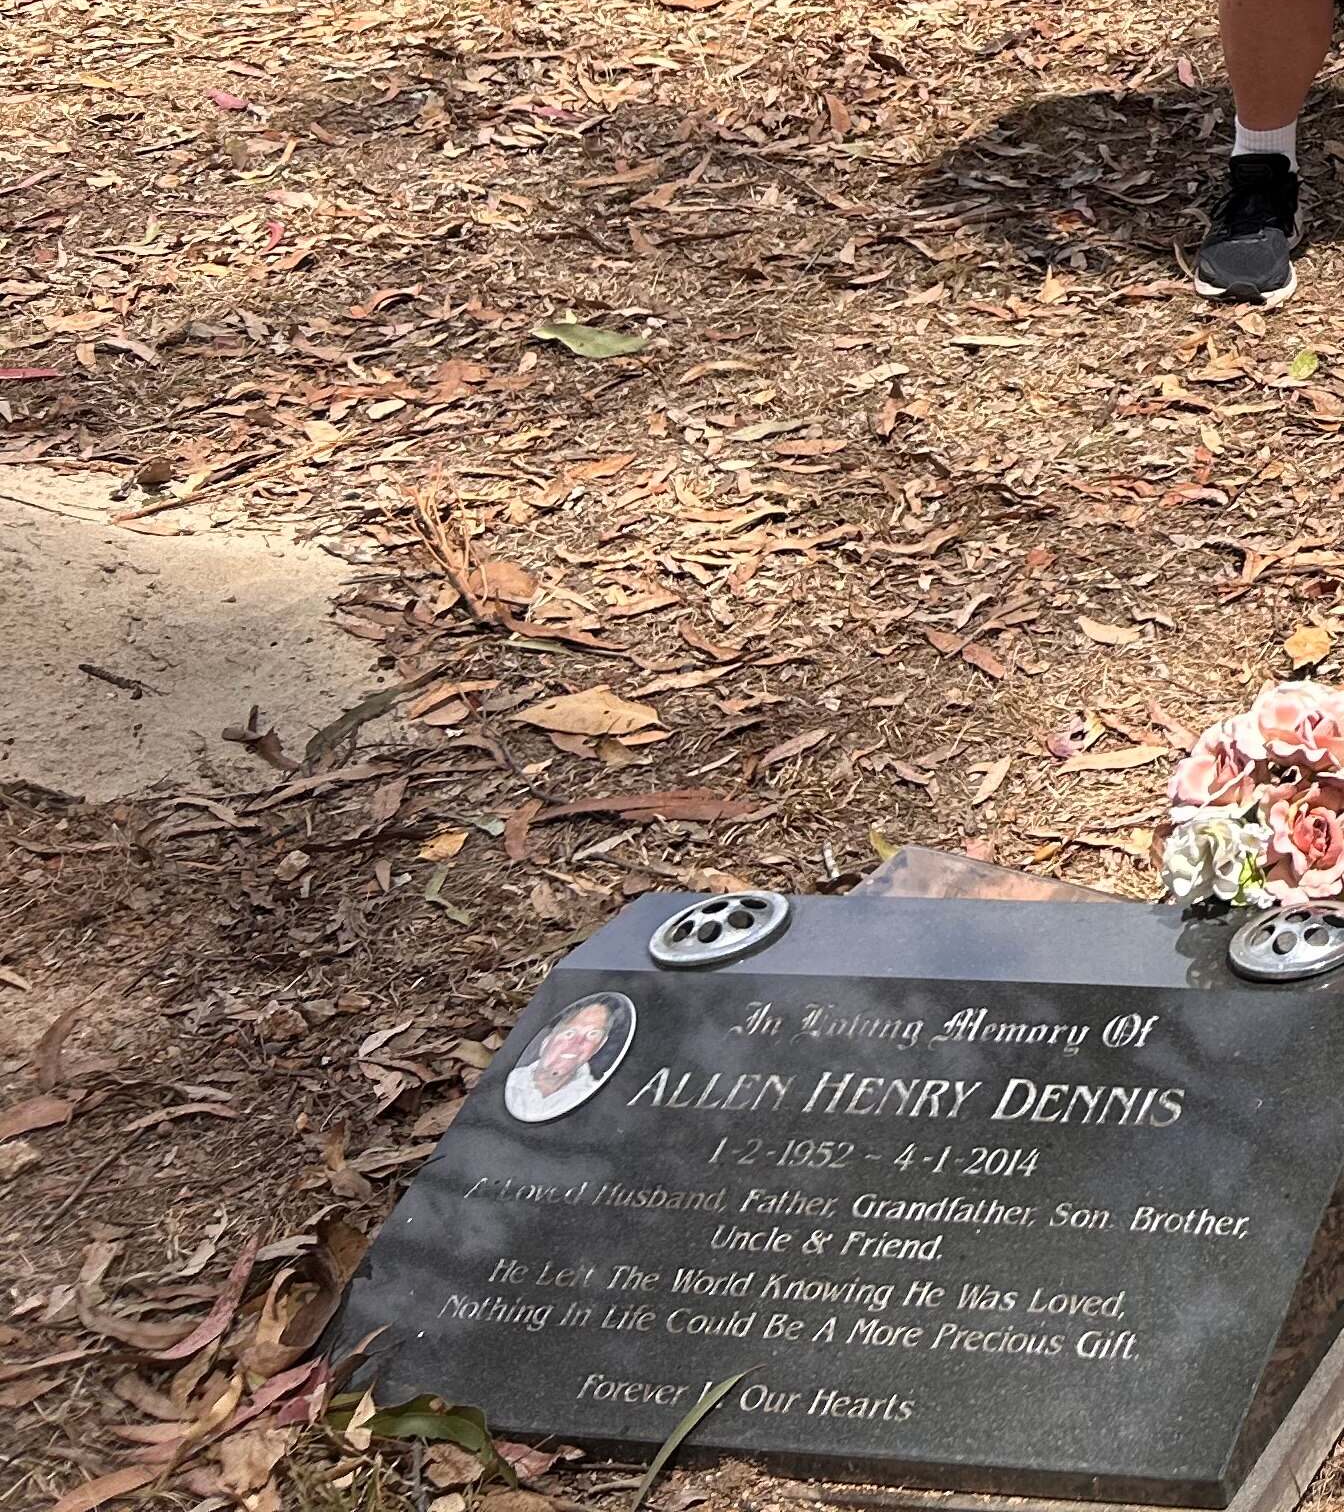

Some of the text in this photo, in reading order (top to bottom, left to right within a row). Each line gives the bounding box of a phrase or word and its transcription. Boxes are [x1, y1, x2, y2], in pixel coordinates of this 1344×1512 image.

[724, 1001, 1160, 1057] In Loving Memory Of
[626, 1066, 1186, 1128] ALLEN HENRY DENNIS
[592, 1182, 728, 1214] Husband,
[739, 1188, 839, 1219] Father,
[852, 1192, 1037, 1228] Grandfather,
[1129, 1206, 1250, 1239] Brother,
[710, 1224, 944, 1261] Uncle & Friend.
[488, 1258, 1126, 1321] He Left The World Knowing He Was Loved,
[436, 1294, 1141, 1361] Nothing In Life Could Be A More Precious Gift.
[576, 1373, 690, 1406] Forever
[740, 1384, 803, 1414] Our
[807, 1389, 916, 1422] Hearts
